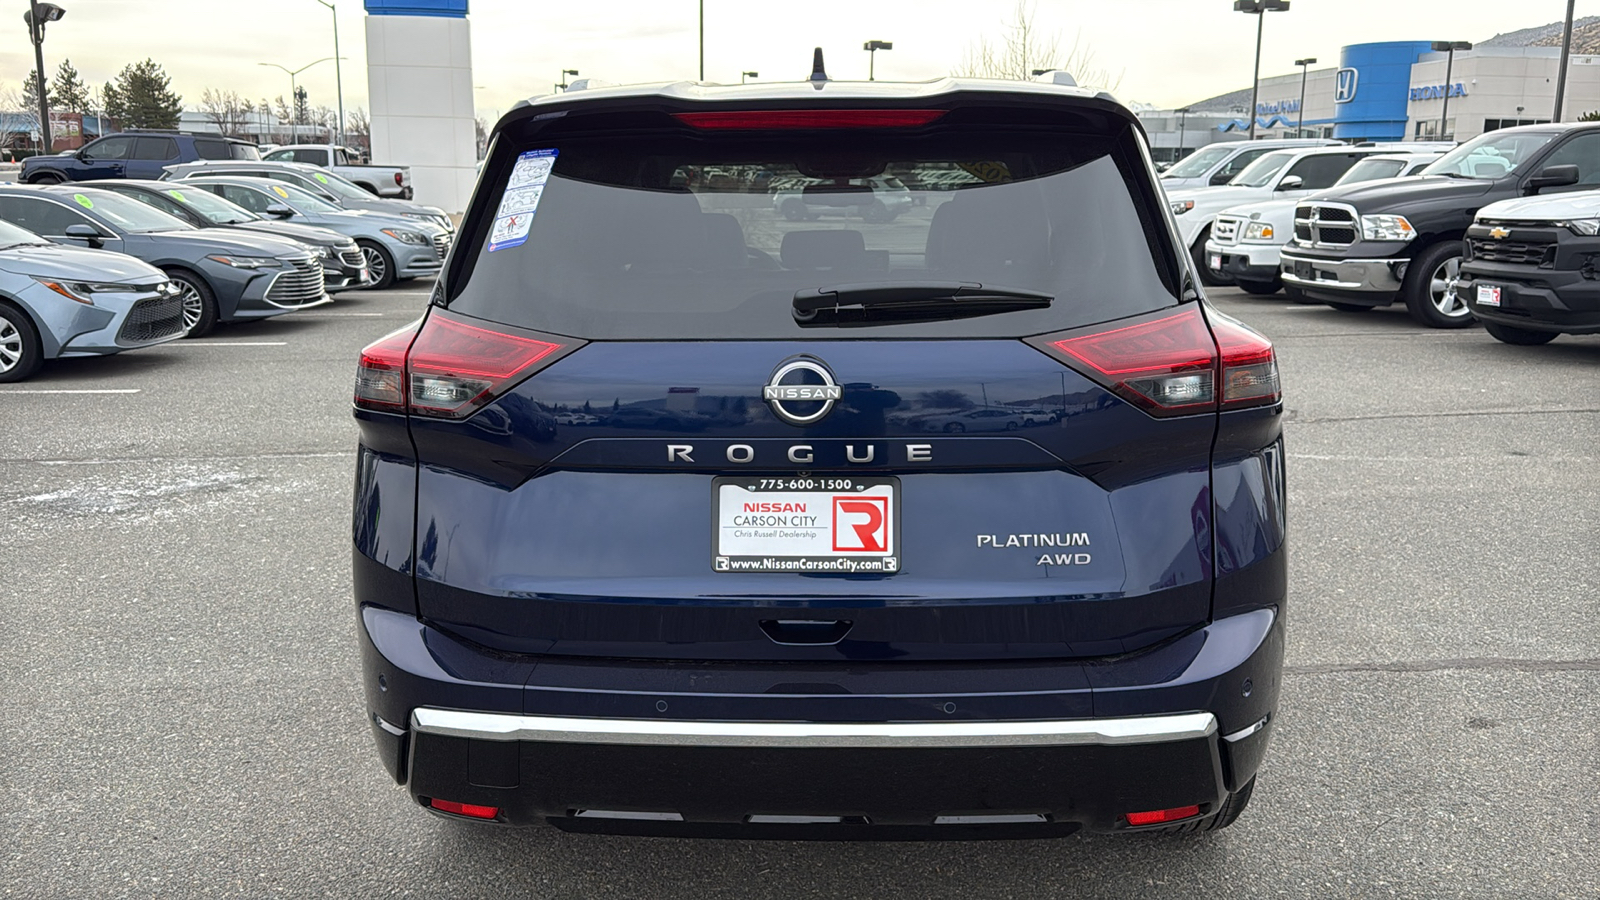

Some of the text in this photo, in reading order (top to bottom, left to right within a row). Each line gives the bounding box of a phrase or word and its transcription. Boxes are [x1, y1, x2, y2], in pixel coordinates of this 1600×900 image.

[766, 387, 840, 399] NISSAN
[667, 444, 933, 463] ROGUE
[760, 479, 852, 490] 775-600-1500
[743, 502, 807, 513] NISSAN
[733, 515, 818, 527] CARSON CITY
[838, 501, 883, 549] R
[733, 529, 817, 540] Chris Russell Dealership
[976, 532, 1091, 548] PLATINUM
[730, 557, 882, 572] www.NissanCarsonCity.com
[1036, 553, 1092, 566] AWD
